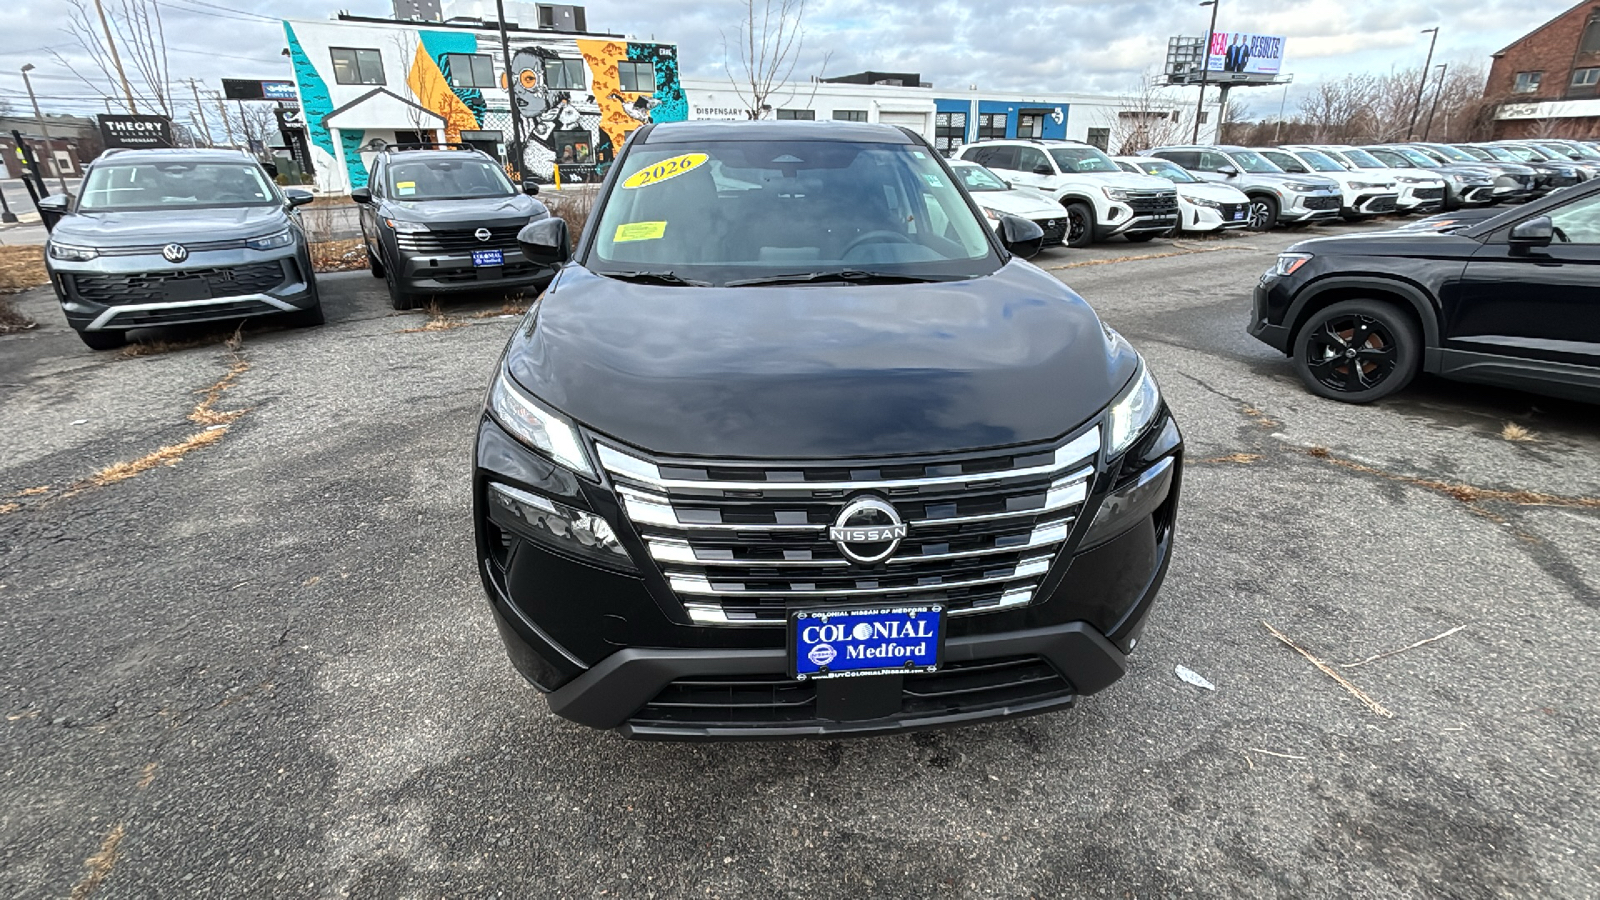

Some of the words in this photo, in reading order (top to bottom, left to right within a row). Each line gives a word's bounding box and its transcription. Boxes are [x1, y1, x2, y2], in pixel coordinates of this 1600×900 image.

[1210, 33, 1227, 55] REAL
[696, 107, 743, 116] DISPENSARY
[105, 121, 162, 131] THEORY
[640, 155, 692, 186] 2026
[831, 526, 906, 541] NISSAN
[811, 611, 849, 619] COLONIAL
[891, 606, 928, 614] MEDFORD
[802, 620, 933, 644] COLONIAL
[846, 642, 926, 659] Medford
